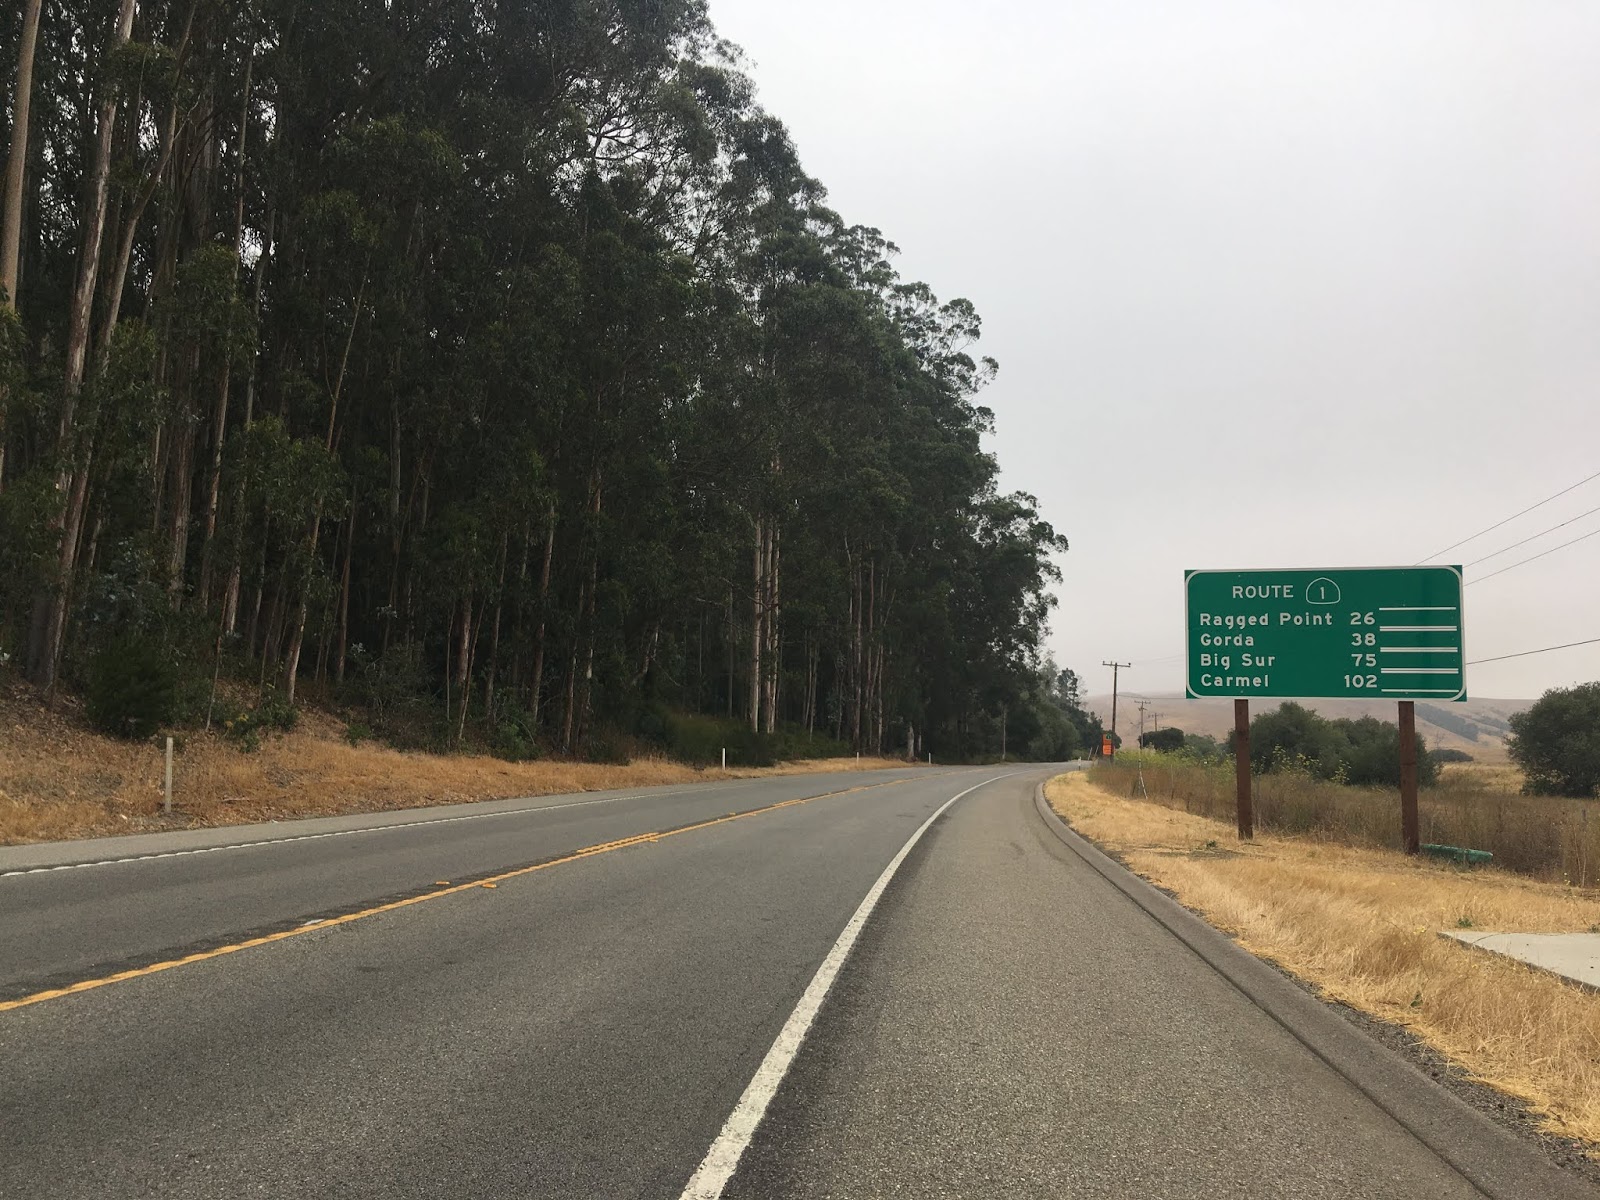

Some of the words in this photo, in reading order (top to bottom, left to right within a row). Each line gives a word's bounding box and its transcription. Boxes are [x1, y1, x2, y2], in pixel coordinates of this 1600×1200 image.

[1232, 585, 1294, 599] ROUTE
[1319, 586, 1325, 600] 1
[1200, 612, 1269, 630] Ragged
[1279, 612, 1333, 626] Point
[1350, 611, 1376, 625] 26
[1200, 633, 1254, 646] Gorda
[1351, 632, 1376, 646] 38
[1200, 653, 1230, 671] Big
[1241, 653, 1276, 667] Sur
[1351, 653, 1377, 667] 75
[1201, 673, 1269, 687] Carmel
[1344, 674, 1378, 688] 102
